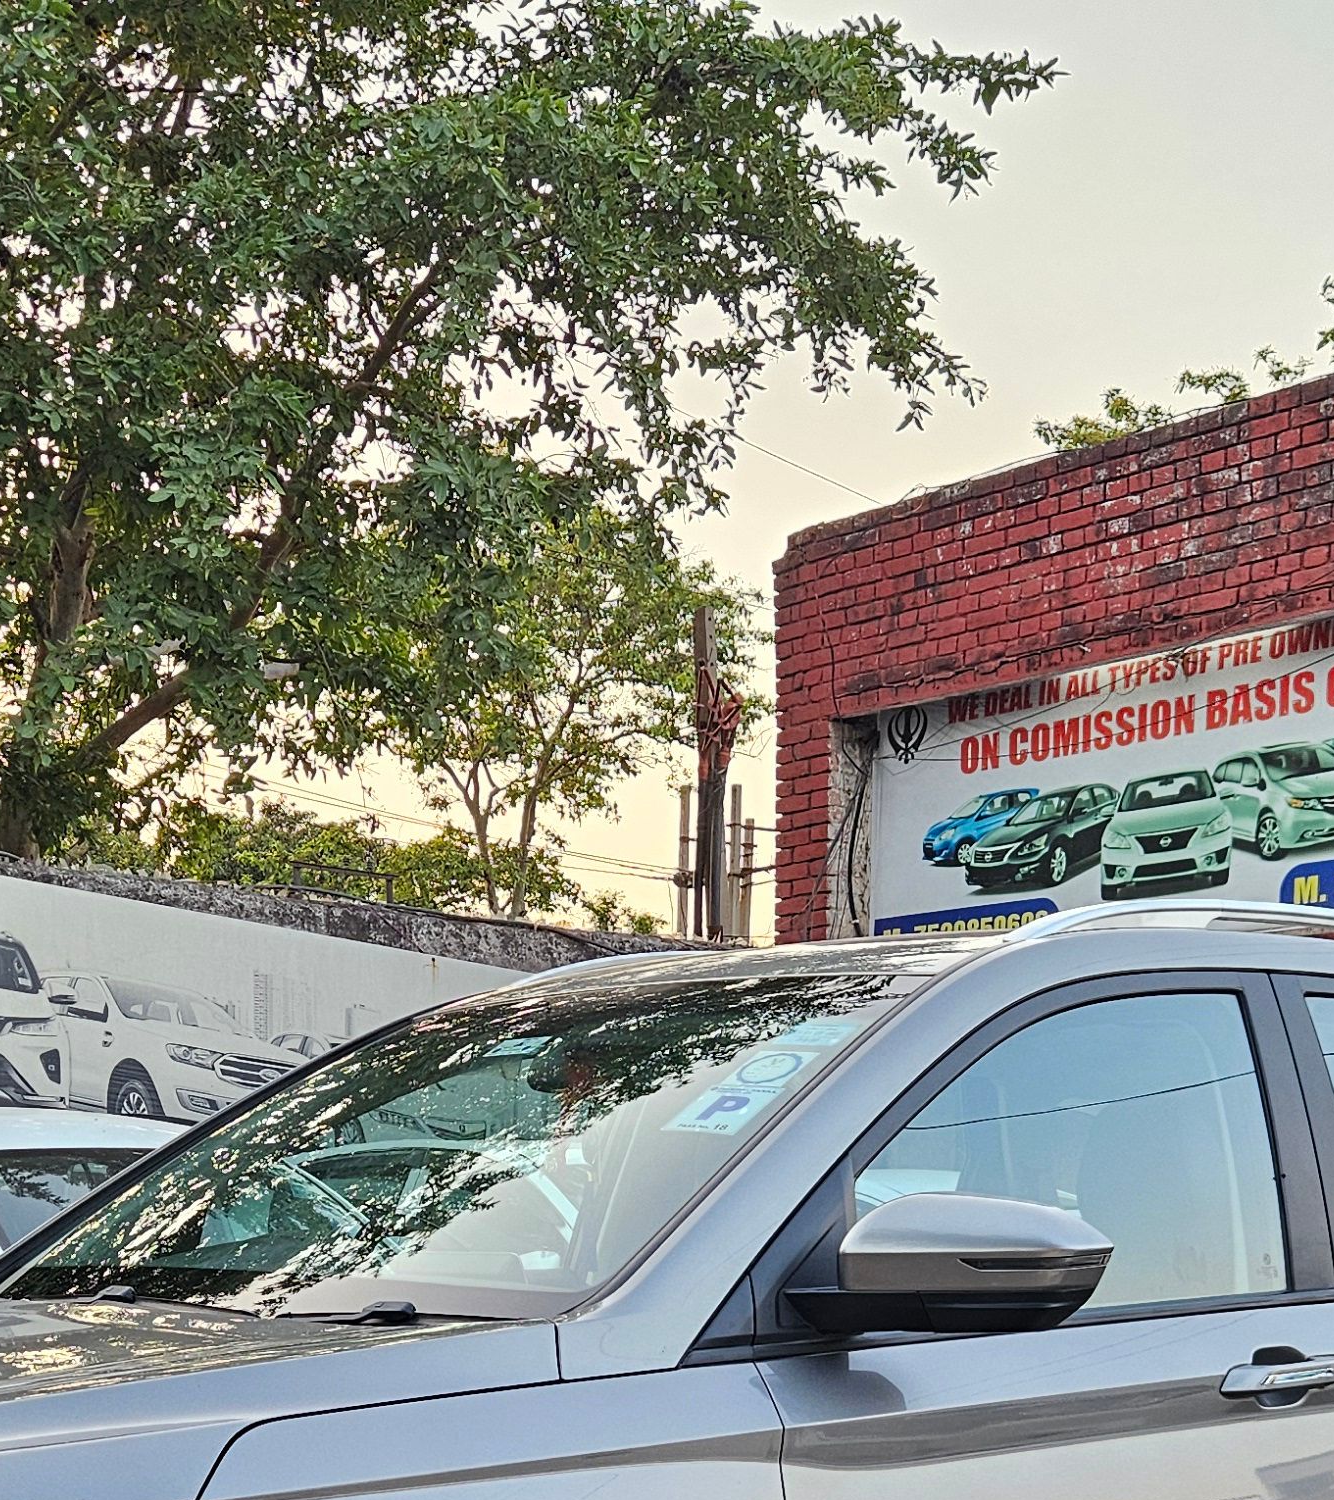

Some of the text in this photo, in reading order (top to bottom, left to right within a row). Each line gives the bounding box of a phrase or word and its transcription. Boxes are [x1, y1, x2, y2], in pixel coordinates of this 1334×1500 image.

[948, 696, 979, 724] WE
[984, 684, 1032, 717] DEAL
[1038, 677, 1061, 706] IN
[1066, 671, 1101, 701] ALL
[1108, 656, 1177, 692] TYPES
[1182, 646, 1211, 676] OF
[1218, 636, 1262, 670] PRE
[960, 731, 999, 774] ON
[1009, 694, 1195, 766] COMISSION
[1205, 670, 1315, 731] BASIS
[1294, 874, 1327, 905] M.
[695, 1095, 750, 1121] P
